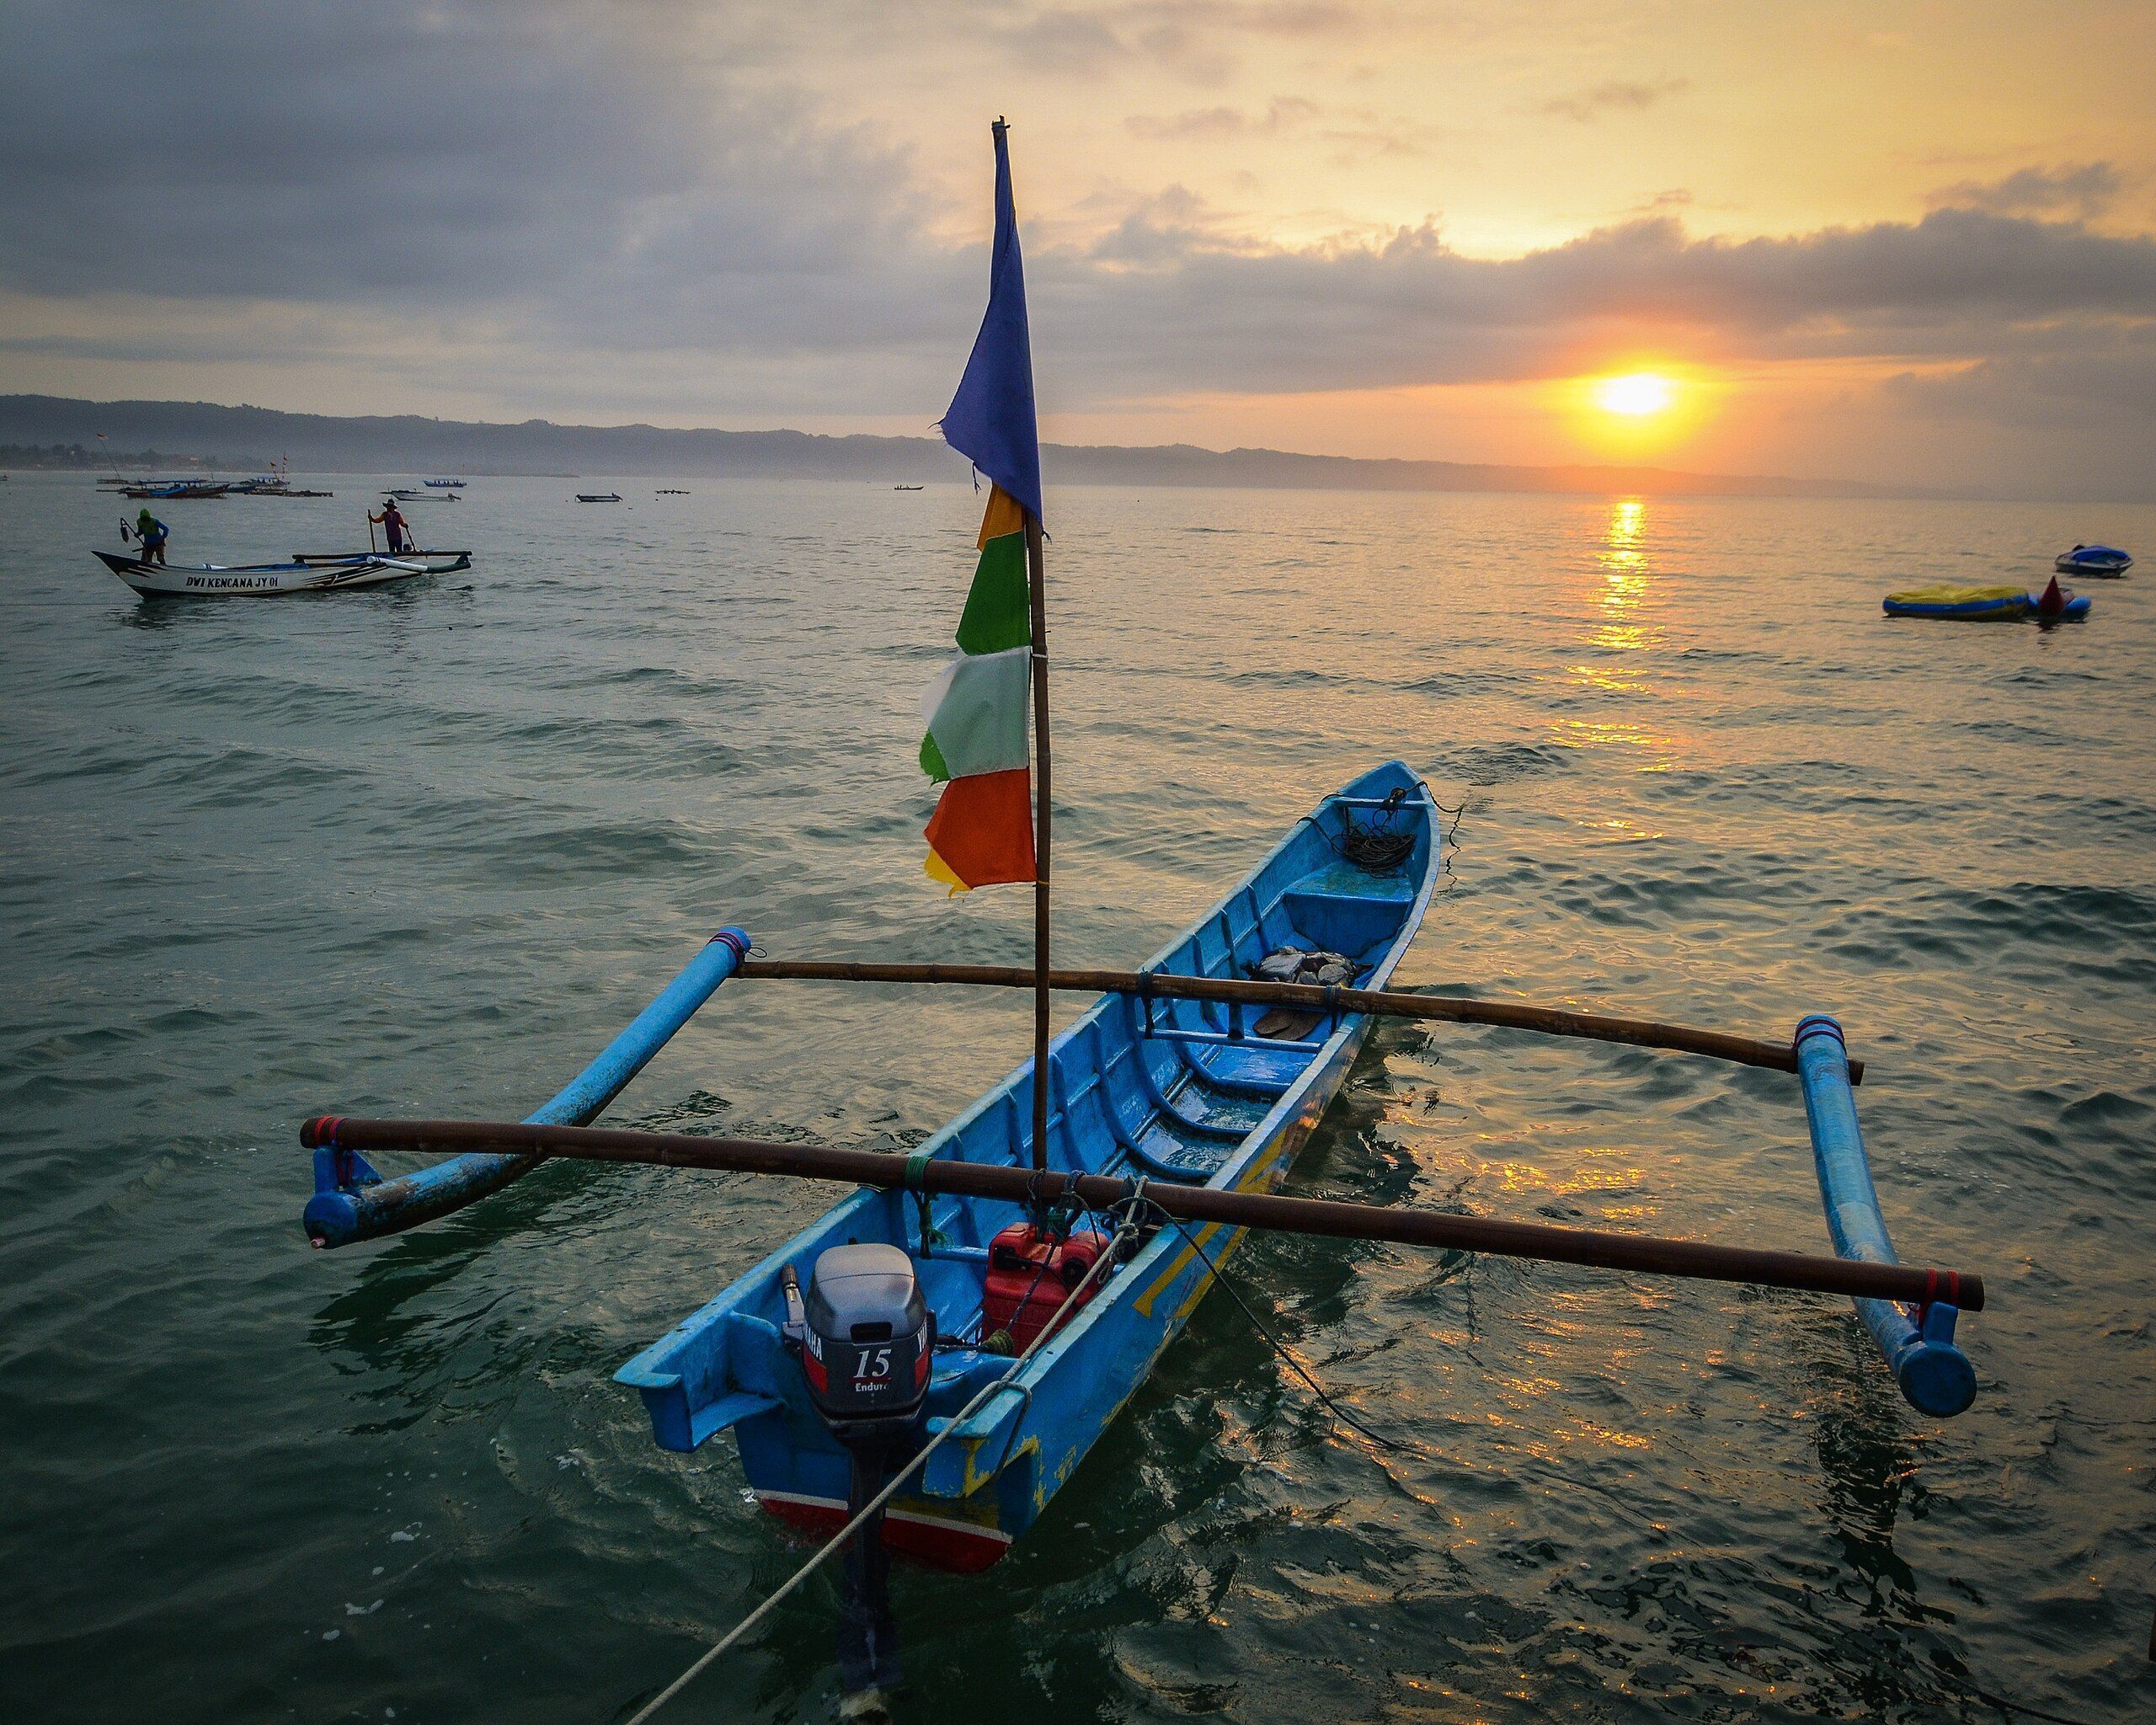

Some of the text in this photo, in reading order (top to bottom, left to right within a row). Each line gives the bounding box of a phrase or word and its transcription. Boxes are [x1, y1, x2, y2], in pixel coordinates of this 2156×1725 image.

[186, 577, 205, 587] DWI
[207, 578, 253, 588] KENCANA
[255, 578, 267, 587] JY
[853, 1348, 892, 1378] 15
